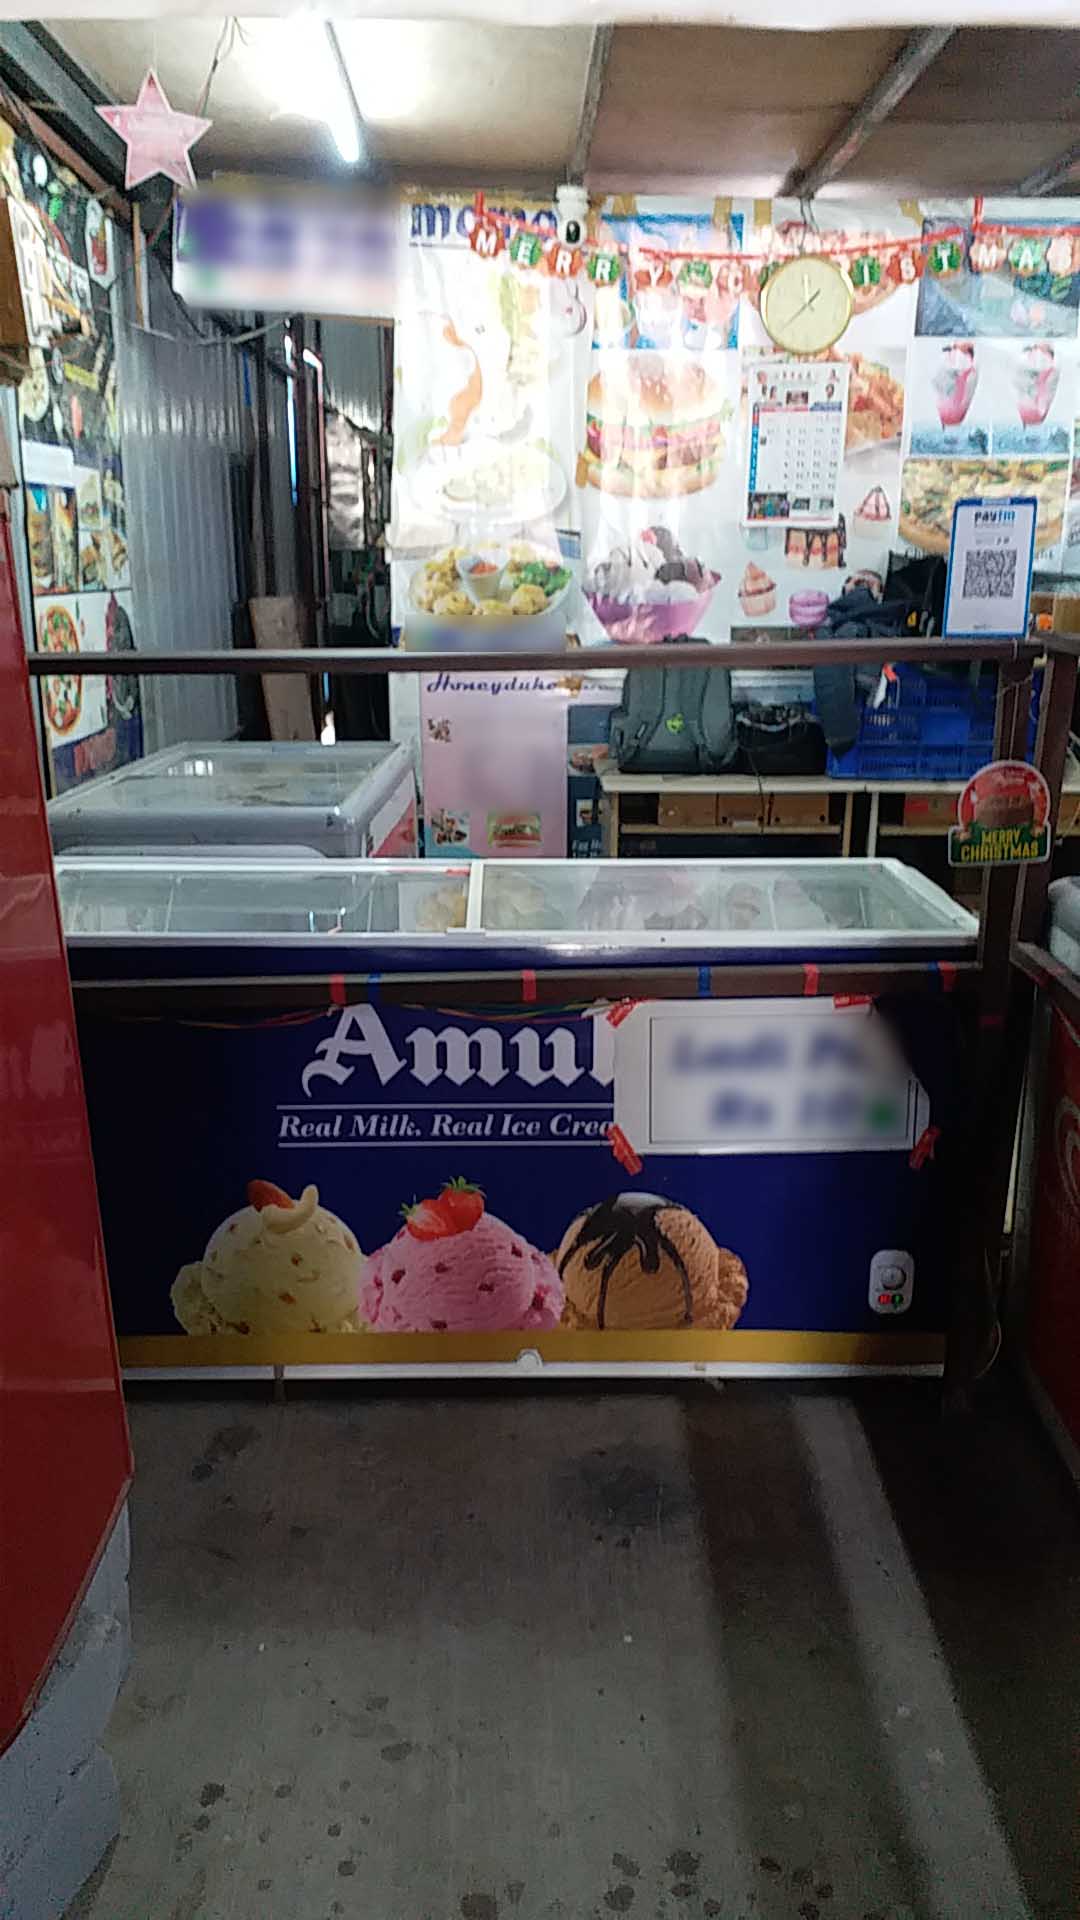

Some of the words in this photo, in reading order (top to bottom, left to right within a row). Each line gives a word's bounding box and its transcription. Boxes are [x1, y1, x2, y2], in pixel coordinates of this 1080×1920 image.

[981, 829, 1021, 846] MERRY
[960, 842, 1039, 863] CHRISTMAS
[302, 1003, 614, 1097] Amul
[279, 1114, 343, 1137] Real
[350, 1114, 422, 1137] Milk.
[430, 1114, 494, 1137] Real
[501, 1113, 541, 1136] Ice
